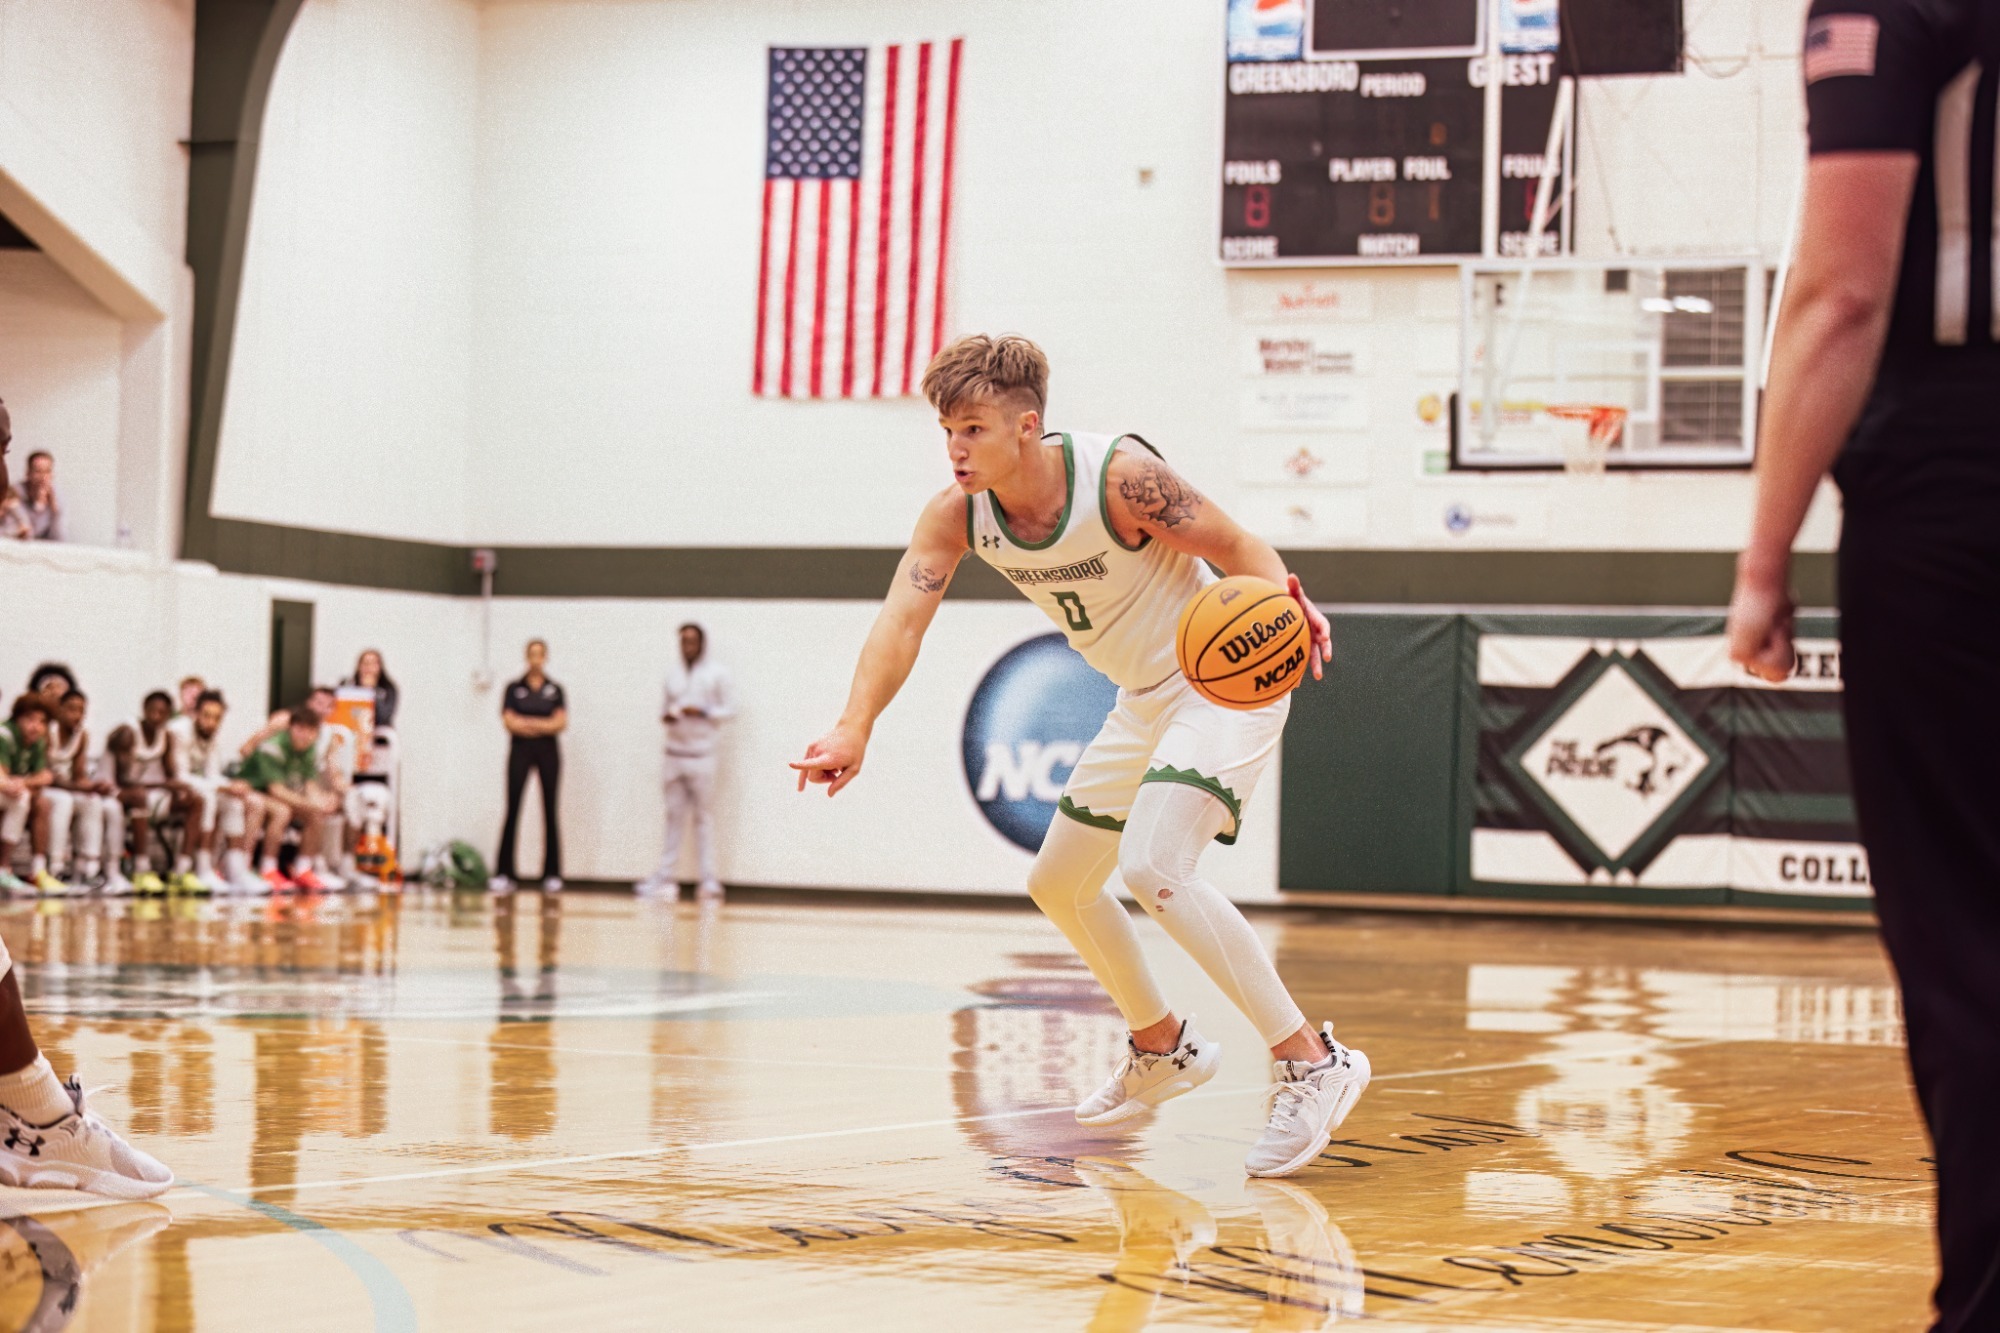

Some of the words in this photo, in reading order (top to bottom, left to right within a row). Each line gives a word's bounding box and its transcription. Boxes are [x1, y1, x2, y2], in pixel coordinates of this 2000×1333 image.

[1229, 62, 1359, 95] GREENSBORO
[1468, 54, 1554, 88] GEST
[1360, 72, 1426, 98] PERIOD
[1225, 160, 1281, 185] FOULS
[1329, 157, 1396, 182] PLAYER
[1403, 156, 1451, 181] FOUL
[1223, 237, 1279, 259] SCORE
[1358, 234, 1419, 256] MATCH
[1500, 232, 1560, 256] SCRE
[1003, 557, 1106, 583] GREENSBORO
[1049, 591, 1093, 631] 0
[1218, 608, 1298, 664] Wilson
[1254, 645, 1305, 692] NCAA
[977, 740, 1080, 801] NC
[1546, 757, 1616, 777] PRIDE
[1780, 855, 1868, 883] COLL
[1098, 1168, 1858, 1319] Memorial
